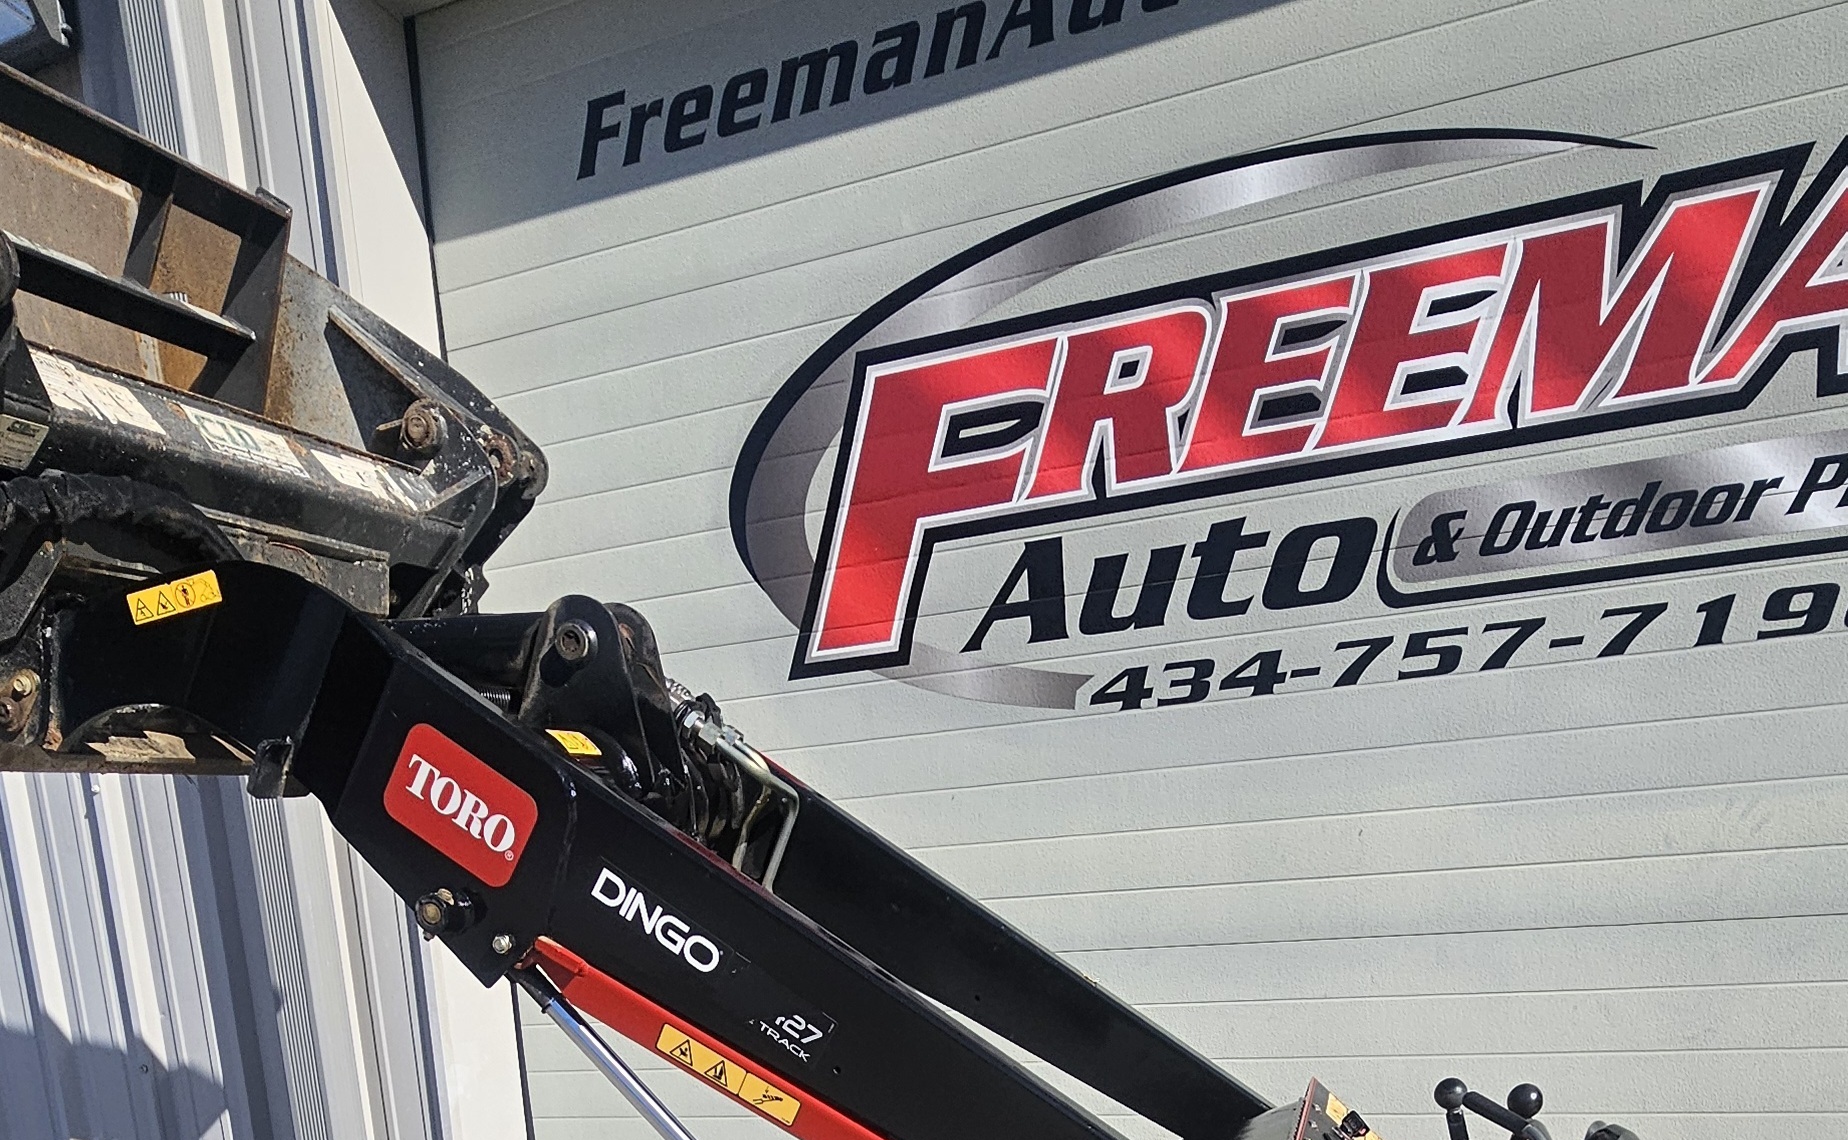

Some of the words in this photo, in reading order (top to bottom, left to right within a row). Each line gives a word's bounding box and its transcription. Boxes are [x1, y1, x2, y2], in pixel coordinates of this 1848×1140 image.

[959, 515, 1379, 653] Auto
[1412, 510, 1467, 567] &
[1479, 475, 1785, 558] Outdoor
[1784, 452, 1848, 516] P
[1089, 582, 1848, 711] 434-757-719
[405, 753, 516, 853] TORO
[591, 867, 720, 973] DINGO
[759, 1020, 811, 1063] TRACK
